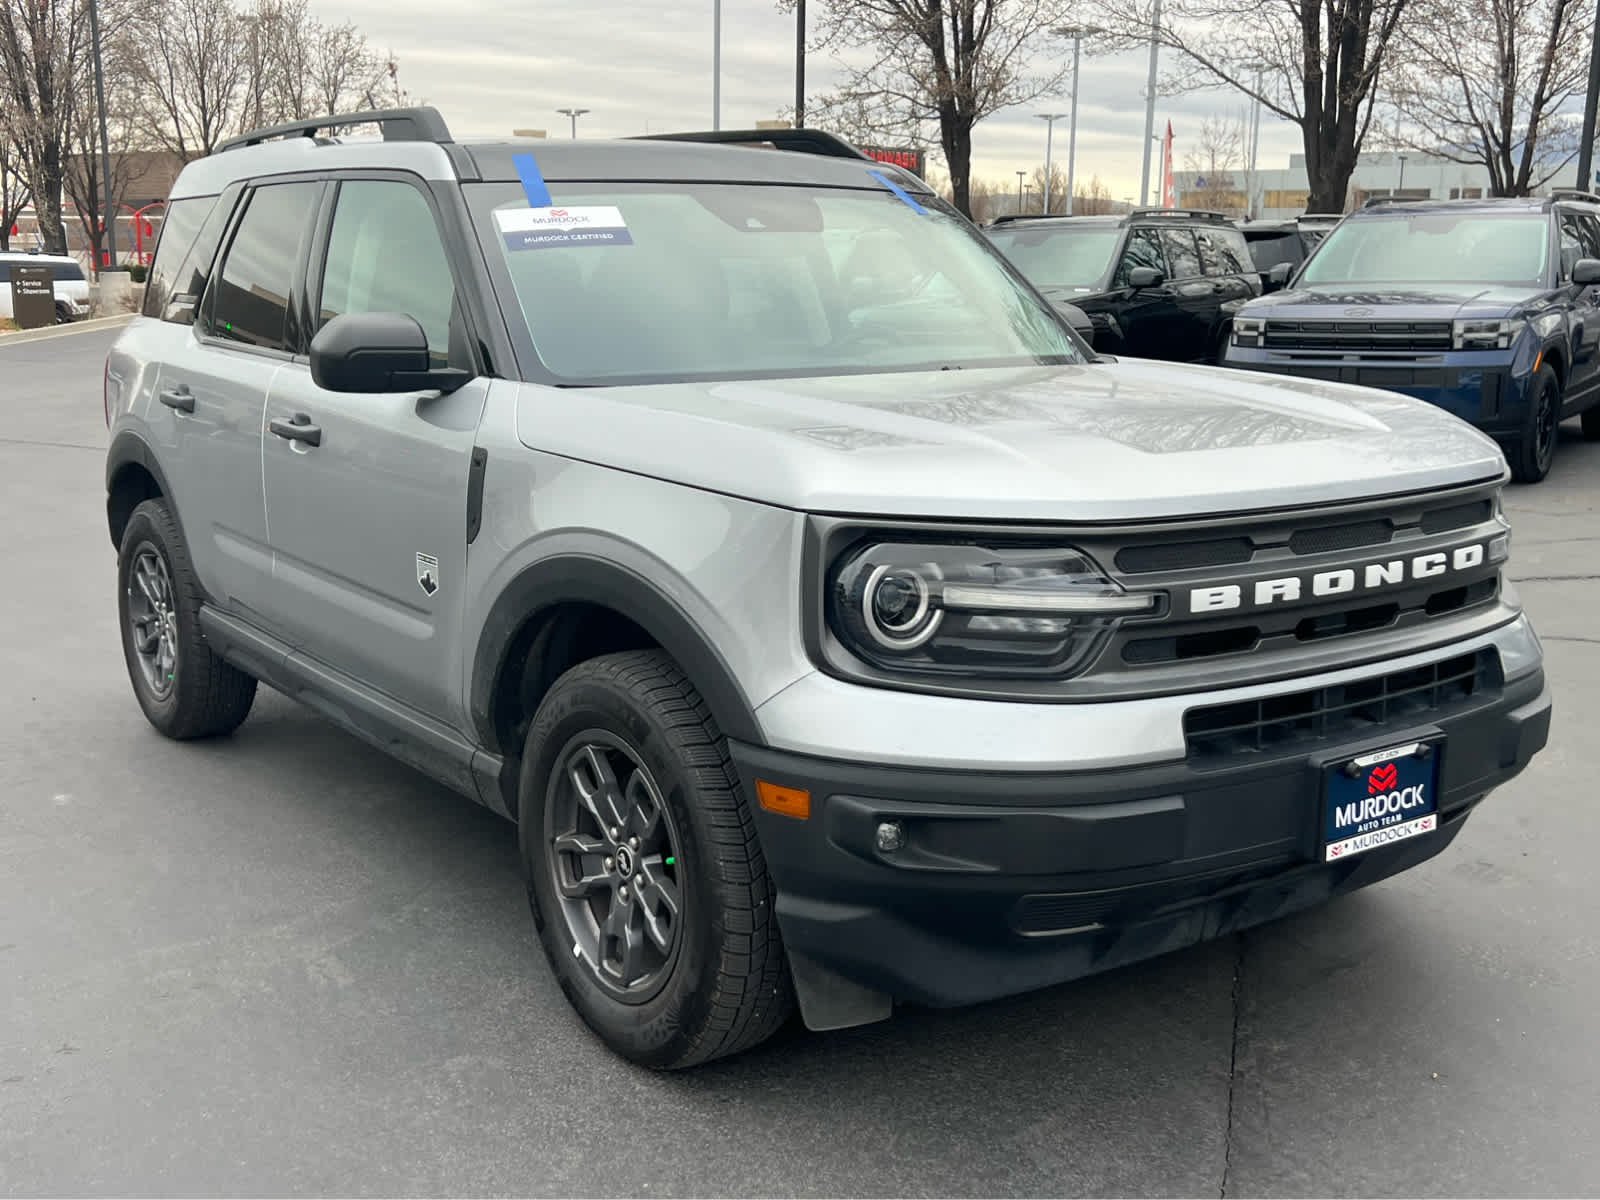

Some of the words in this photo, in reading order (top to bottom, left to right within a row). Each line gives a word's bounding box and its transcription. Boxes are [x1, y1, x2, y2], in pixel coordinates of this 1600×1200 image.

[532, 215, 591, 225] MURDOCK
[524, 234, 569, 244] MURDOCK
[570, 232, 614, 241] CERTIFIED
[1190, 544, 1484, 613] BRONCO
[1335, 783, 1424, 828] MURDOCK
[1358, 820, 1379, 832] AUTO
[1381, 813, 1402, 824] TEAM
[1353, 824, 1412, 850] MURDOCK
